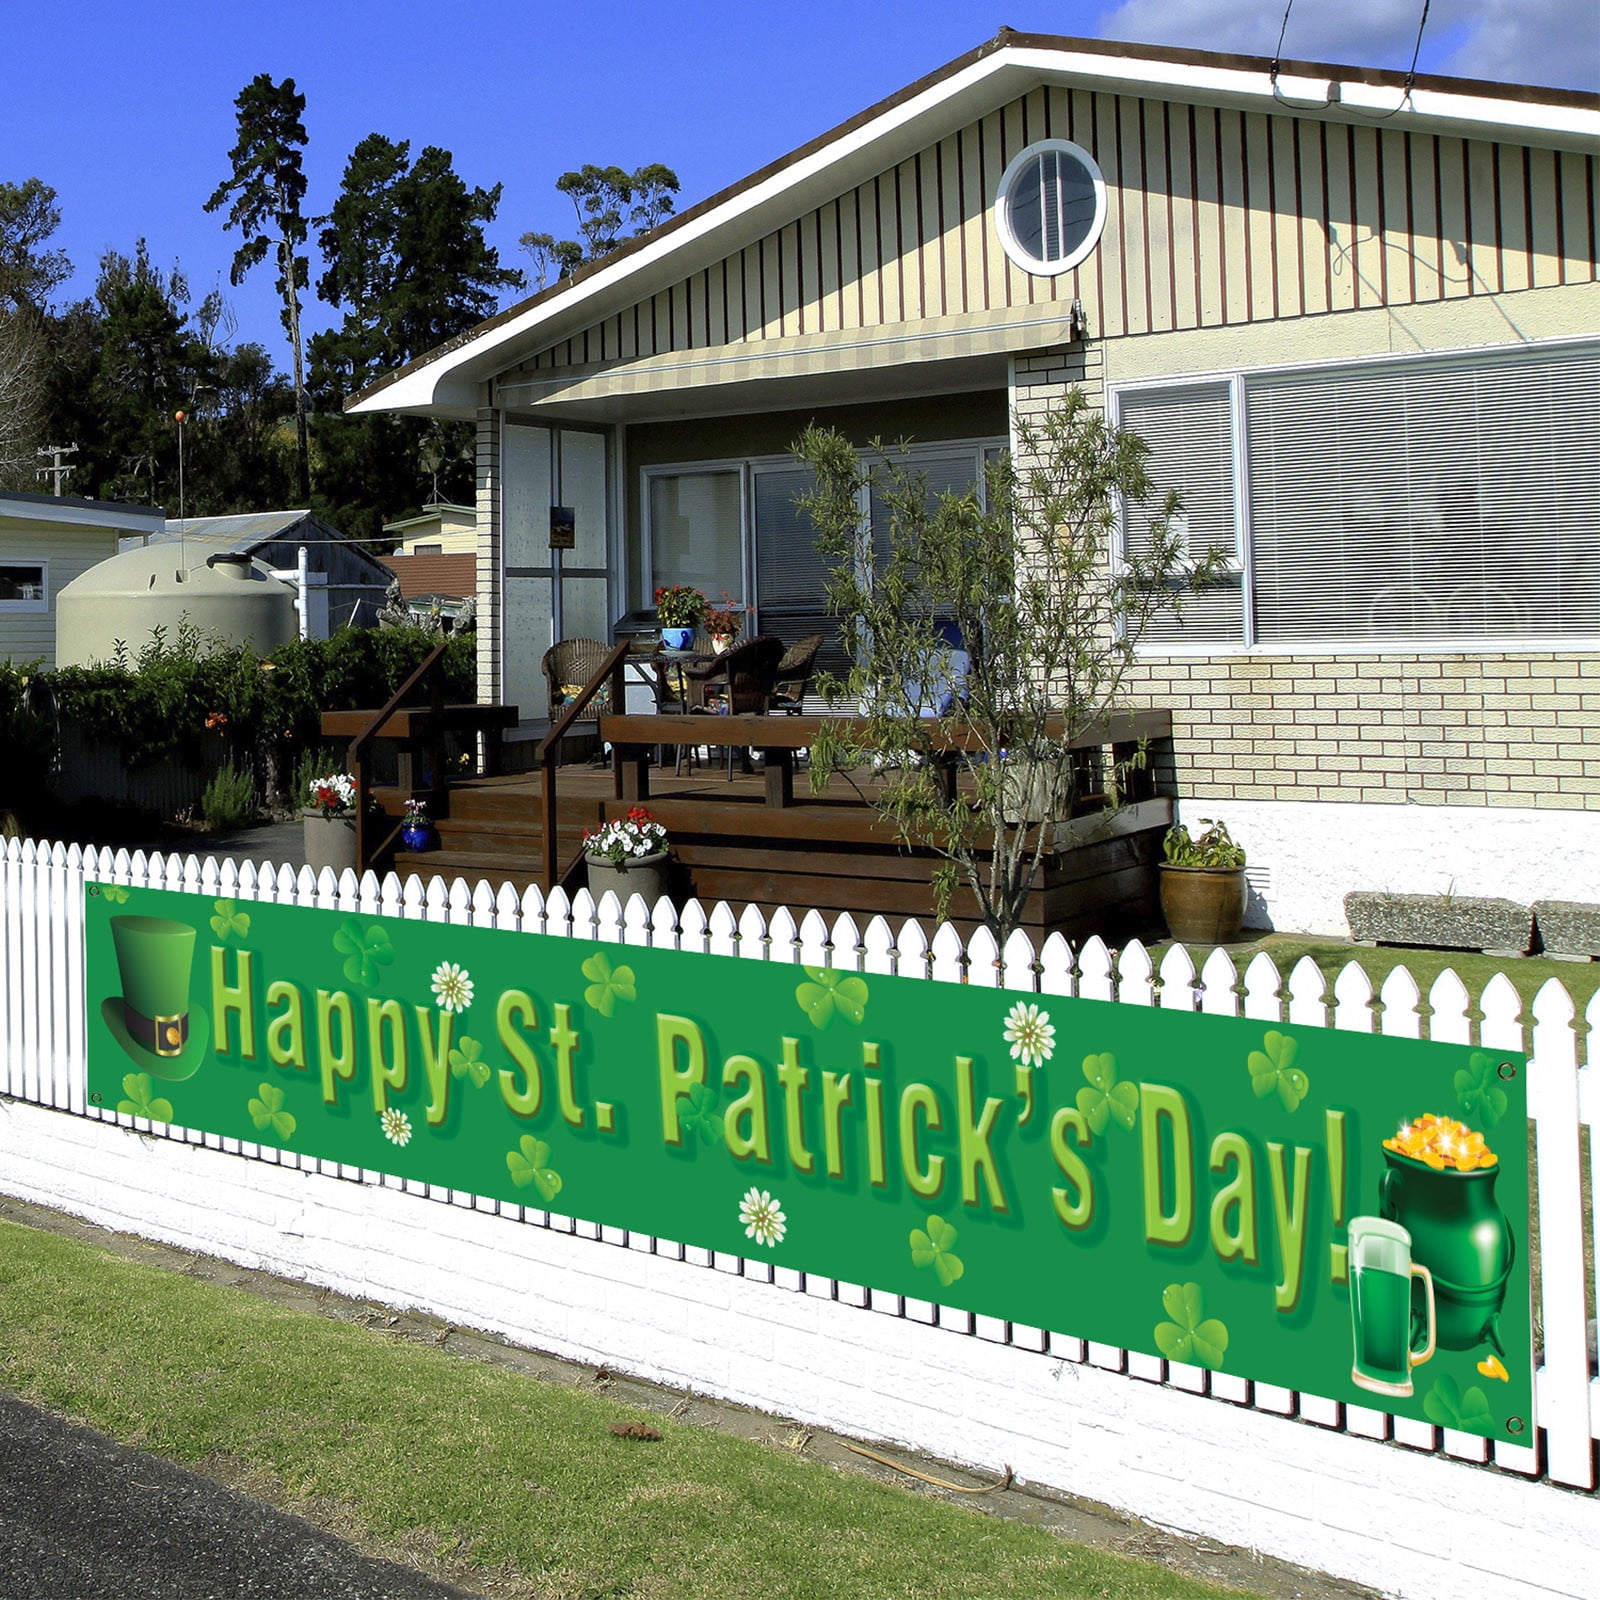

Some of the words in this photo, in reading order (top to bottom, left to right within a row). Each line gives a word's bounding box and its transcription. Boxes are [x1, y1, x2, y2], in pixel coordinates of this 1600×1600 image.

[211, 945, 455, 1127] Happy
[496, 989, 615, 1133] St.
[656, 1012, 1095, 1231] Patrick's
[1139, 1082, 1349, 1313] Day!
